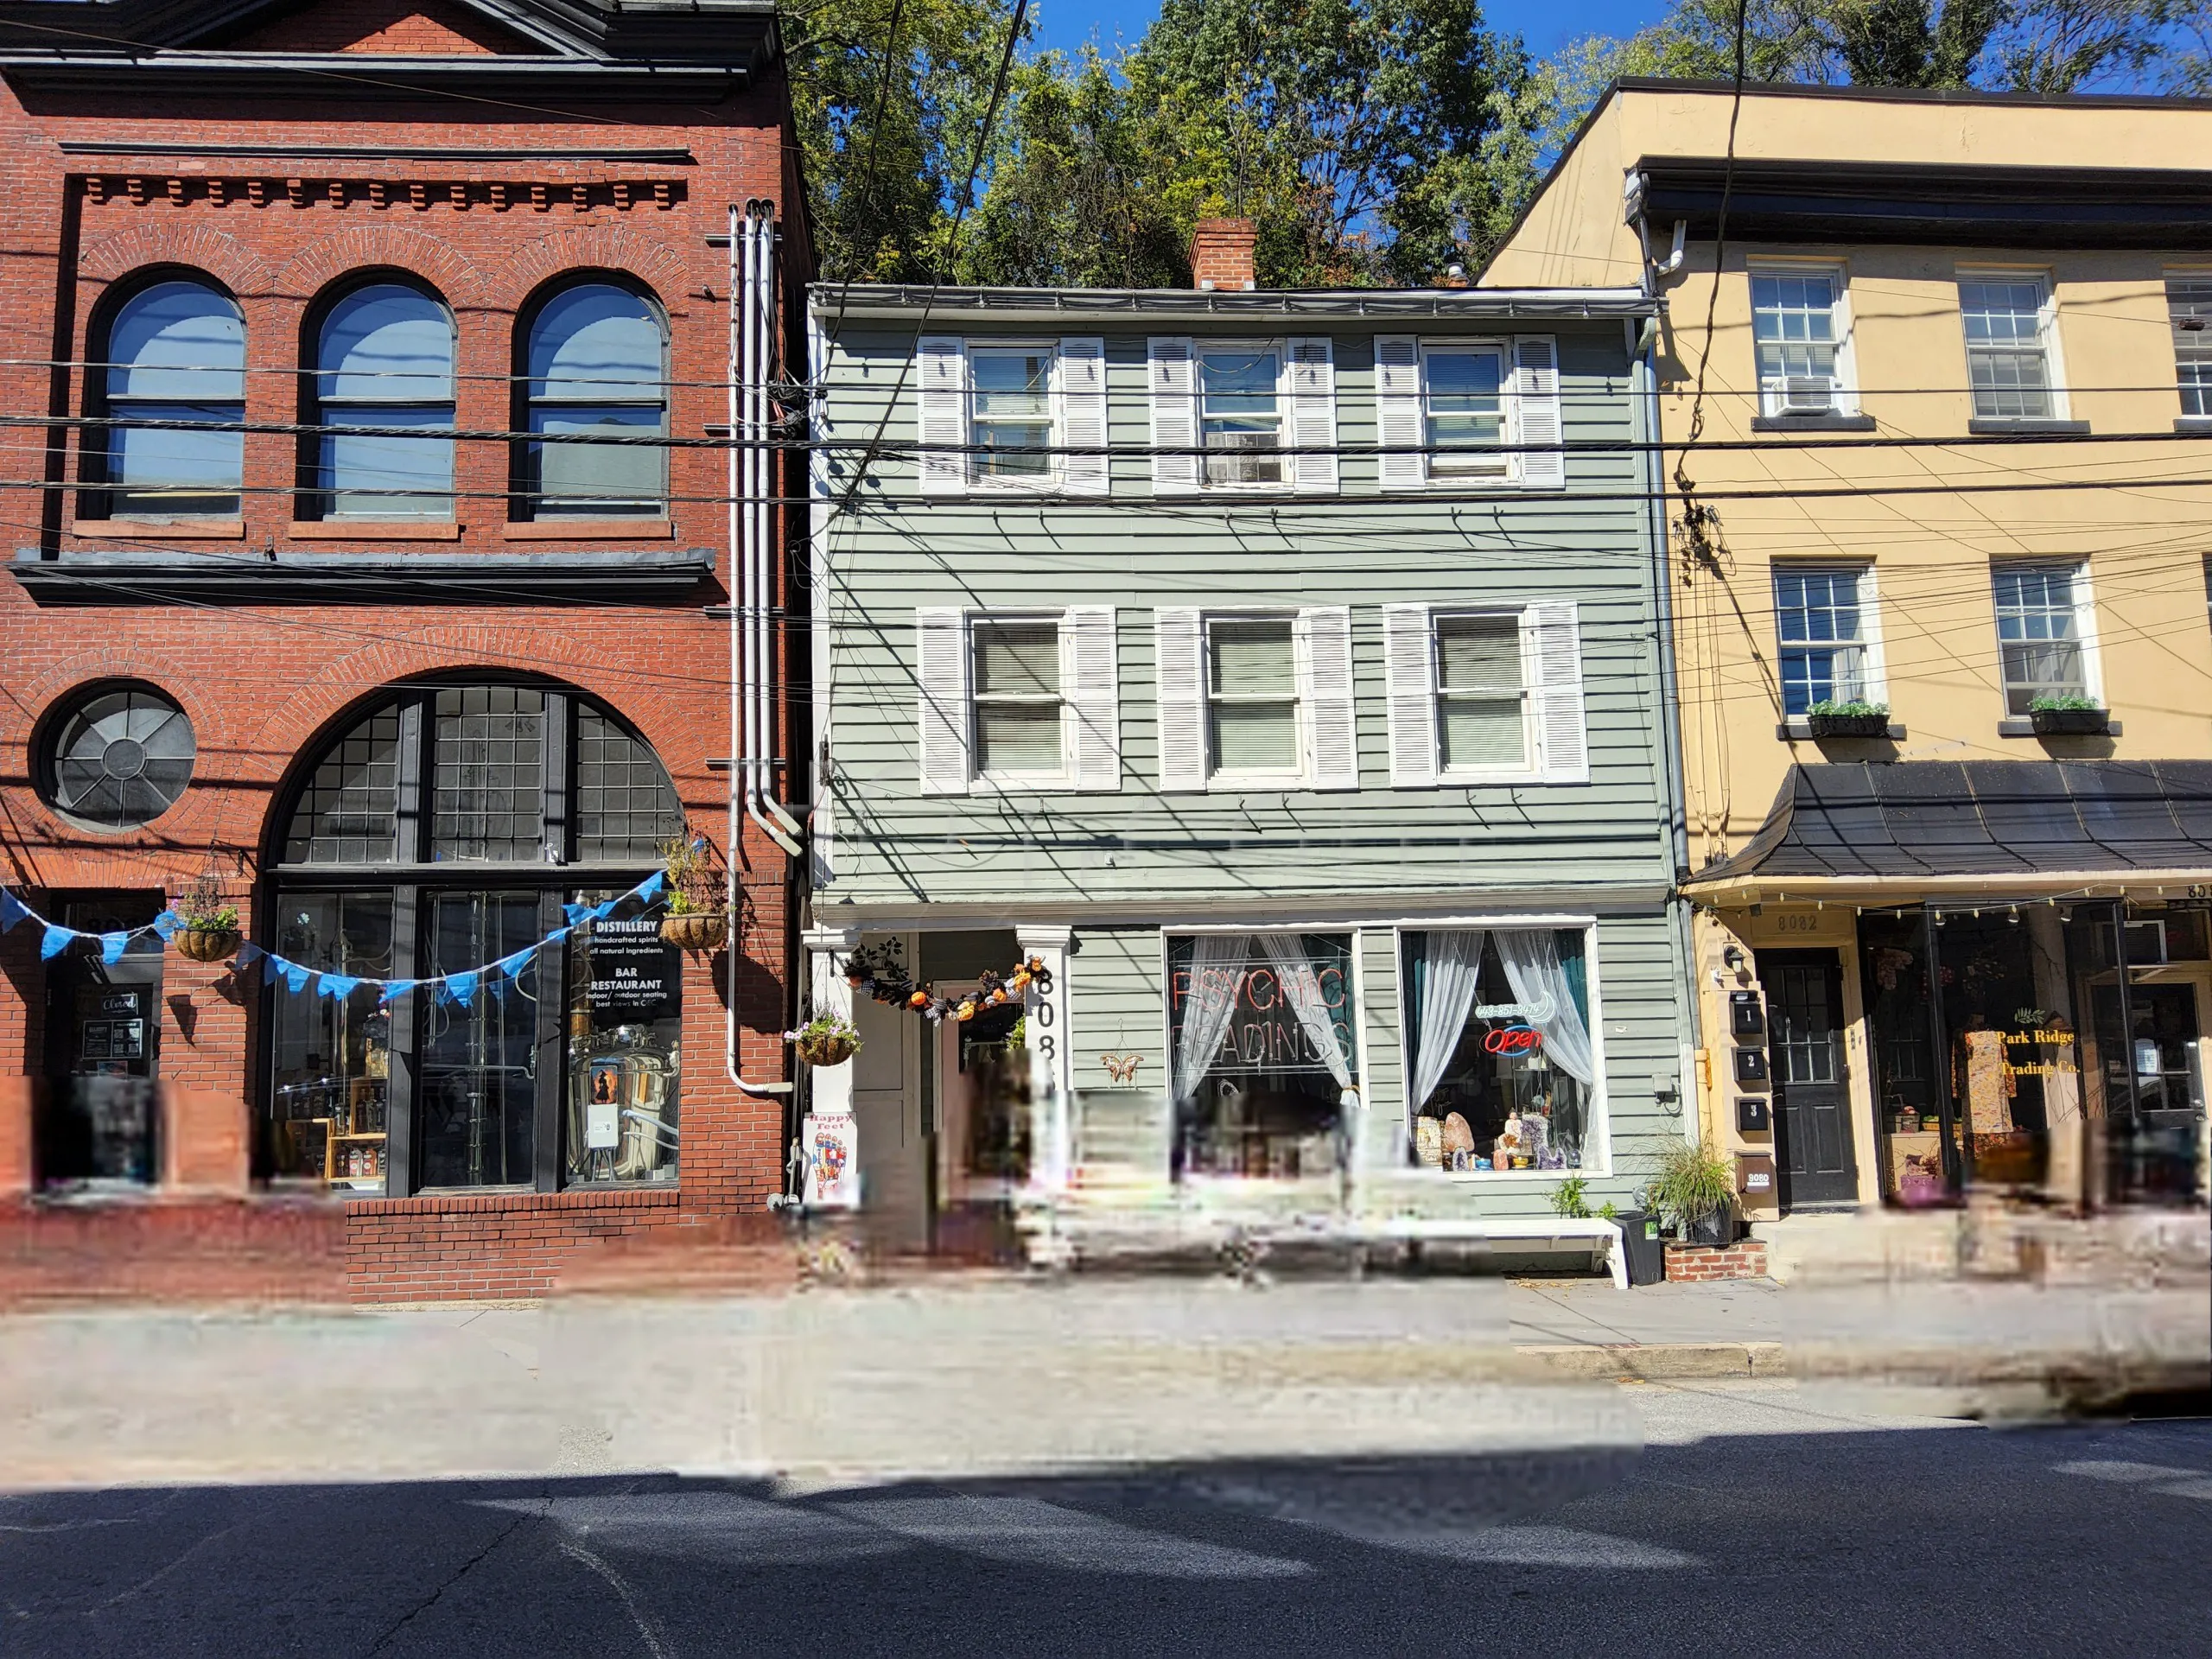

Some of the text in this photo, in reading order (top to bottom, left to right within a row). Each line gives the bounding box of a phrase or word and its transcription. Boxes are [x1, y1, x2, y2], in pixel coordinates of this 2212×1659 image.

[2188, 884, 2212, 898] 80
[596, 921, 658, 932] DISTILLERY
[1778, 915, 1817, 931] 8082
[615, 967, 638, 977] BAR
[590, 980, 662, 990] RESTAURANT
[1173, 968, 1345, 1011] PSYCHIC
[613, 990, 641, 999] outdoor
[103, 997, 137, 1011] Closed
[1745, 1009, 1751, 1022] 1
[1037, 967, 1056, 1092] 808
[1484, 1029, 1542, 1053] Open
[1997, 1029, 2075, 1046] Park Ridge
[1747, 1055, 1755, 1067] 2
[1999, 1060, 2081, 1078] Trading Co.
[1750, 1104, 1758, 1117] 3
[1748, 1173, 1770, 1182] 8080
